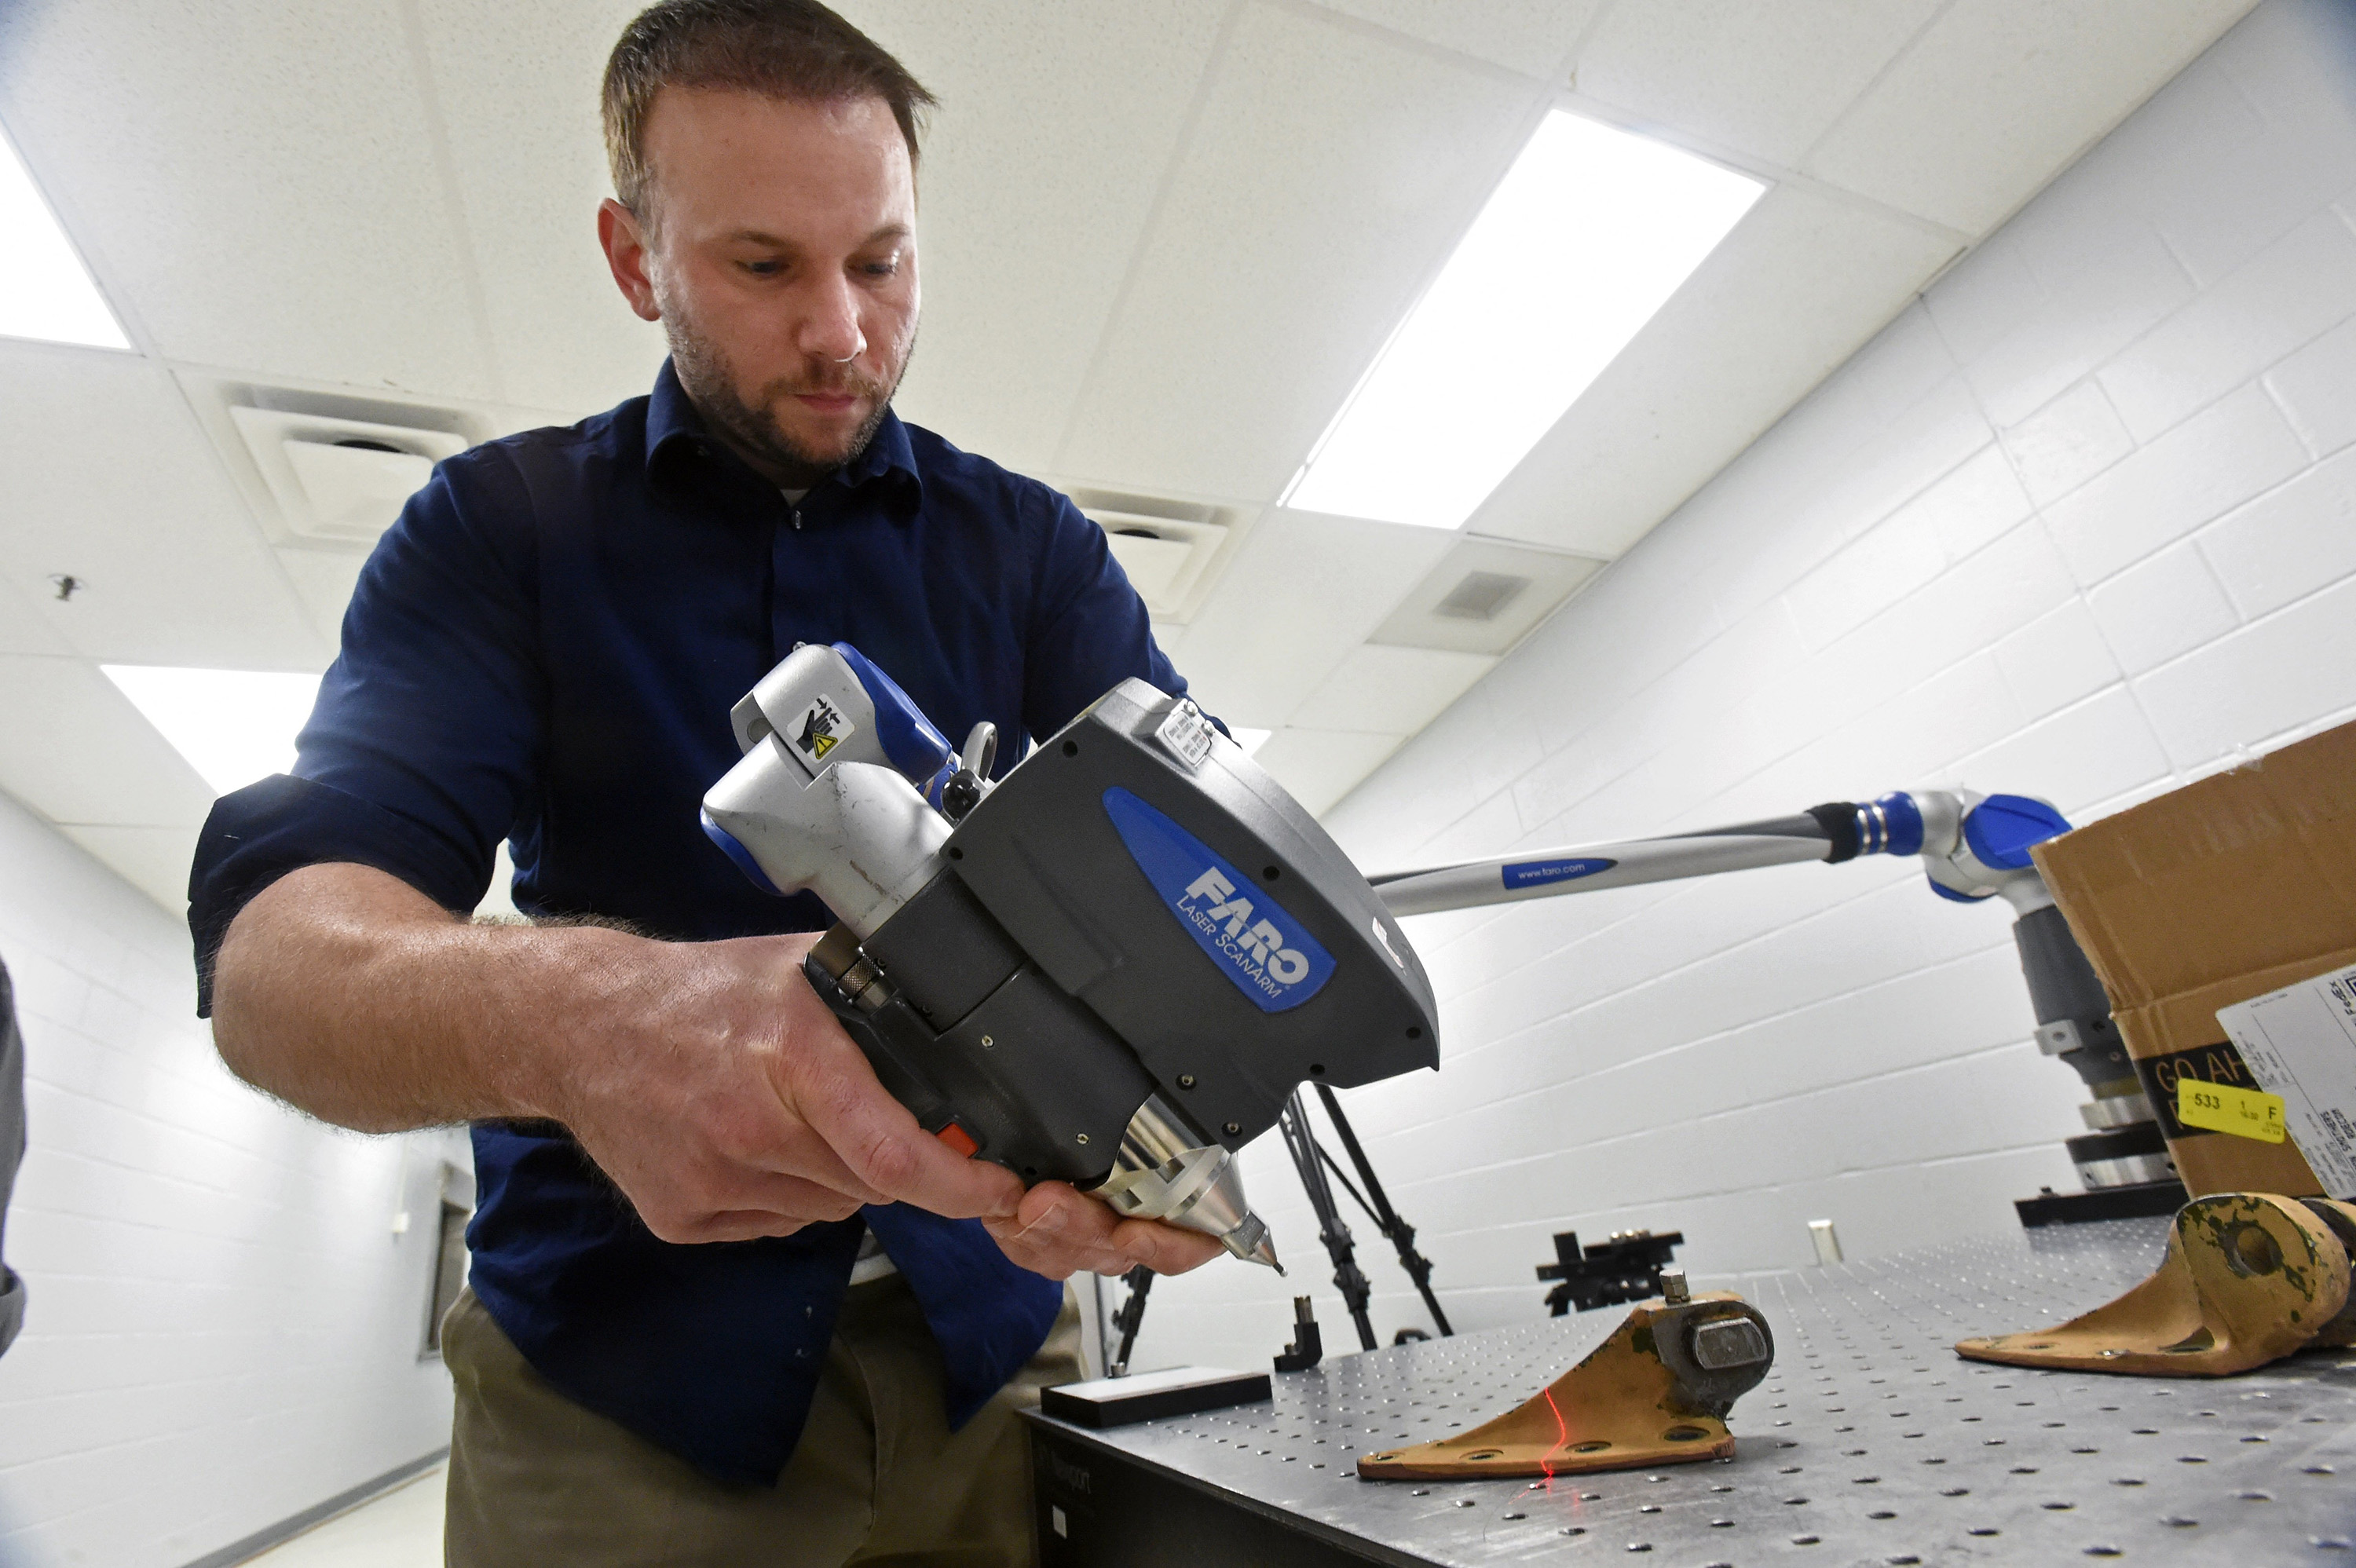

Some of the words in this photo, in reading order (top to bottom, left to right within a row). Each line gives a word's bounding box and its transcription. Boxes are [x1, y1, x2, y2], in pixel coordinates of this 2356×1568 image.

[1176, 895, 1216, 935] LASER
[1215, 933, 1283, 999] SCANARM
[1185, 866, 1309, 985] FARO
[2194, 1093, 2221, 1109] 533
